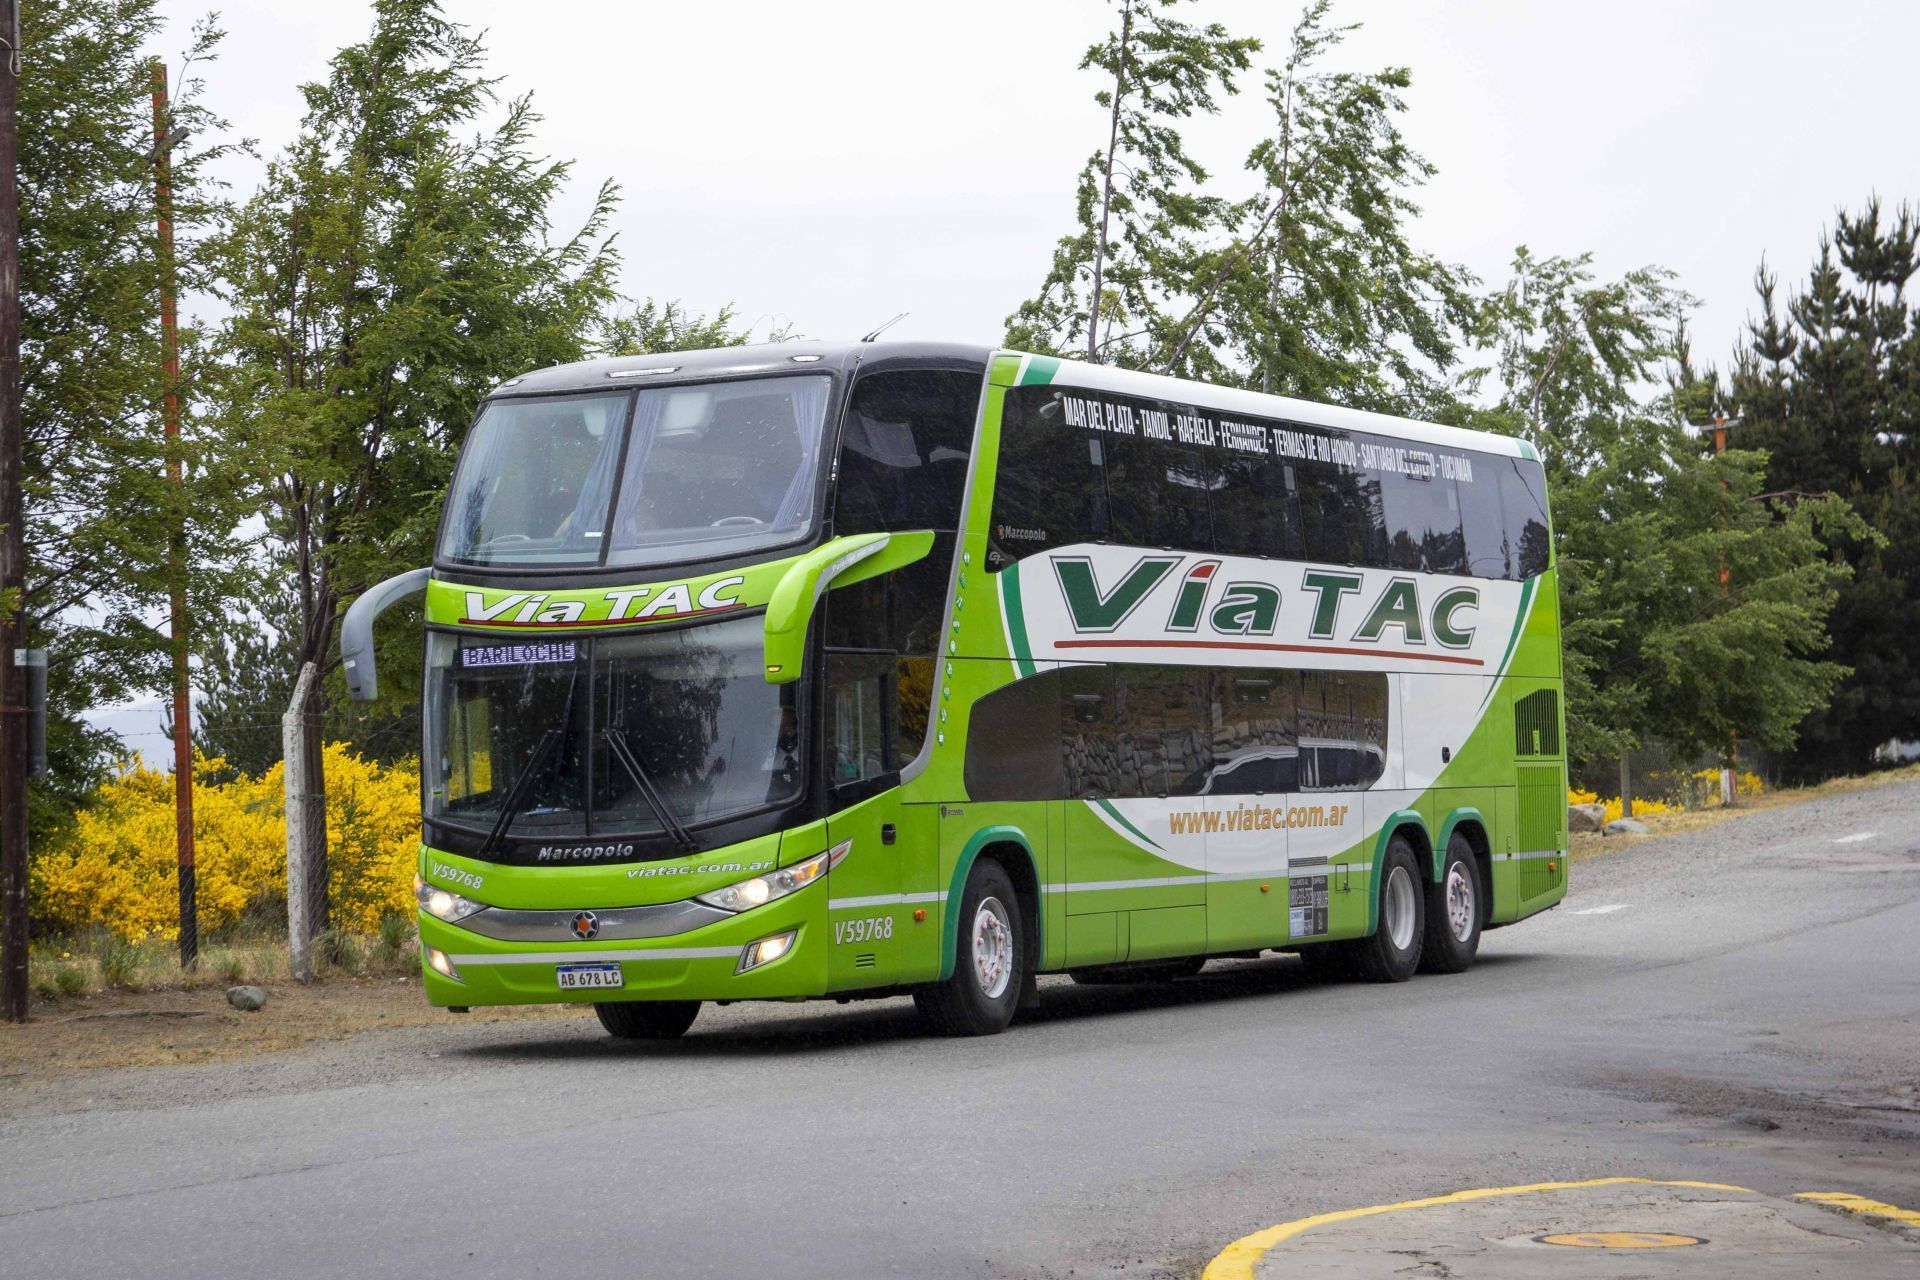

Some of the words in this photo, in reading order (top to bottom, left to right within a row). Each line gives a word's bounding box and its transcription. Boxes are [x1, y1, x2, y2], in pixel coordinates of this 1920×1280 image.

[1063, 396, 1087, 428] MAR
[1086, 400, 1106, 431] DEL
[1105, 402, 1135, 435] PLATA
[1139, 408, 1172, 440] TANDIL
[1176, 414, 1216, 446] RAFAELA
[1220, 420, 1269, 453] FERNANDEZ
[1272, 428, 1306, 459] TERMAS
[1305, 433, 1317, 460] DE
[1316, 435, 1331, 463] RIO
[1330, 437, 1357, 467] HONDO
[1360, 443, 1396, 472] SANTIAGO
[1395, 447, 1410, 474] DEL
[1409, 450, 1436, 478] ESTERO
[1439, 453, 1473, 482] TUCUMÁN
[1005, 525, 1046, 541] Marcopolo
[465, 591, 587, 623] Via
[602, 576, 745, 621] TAC
[1049, 554, 1283, 637] Via
[1300, 567, 1482, 650] TAC
[462, 641, 576, 668] BARILOCHE
[1169, 803, 1349, 834] www.viatac.com.ar
[538, 843, 634, 862] Marcopolo
[432, 862, 484, 890] V59768
[627, 859, 775, 879] viatac.com.ar
[835, 915, 894, 946] V59768
[561, 973, 576, 986] AB
[579, 972, 601, 985] 678
[603, 971, 619, 984] LC
